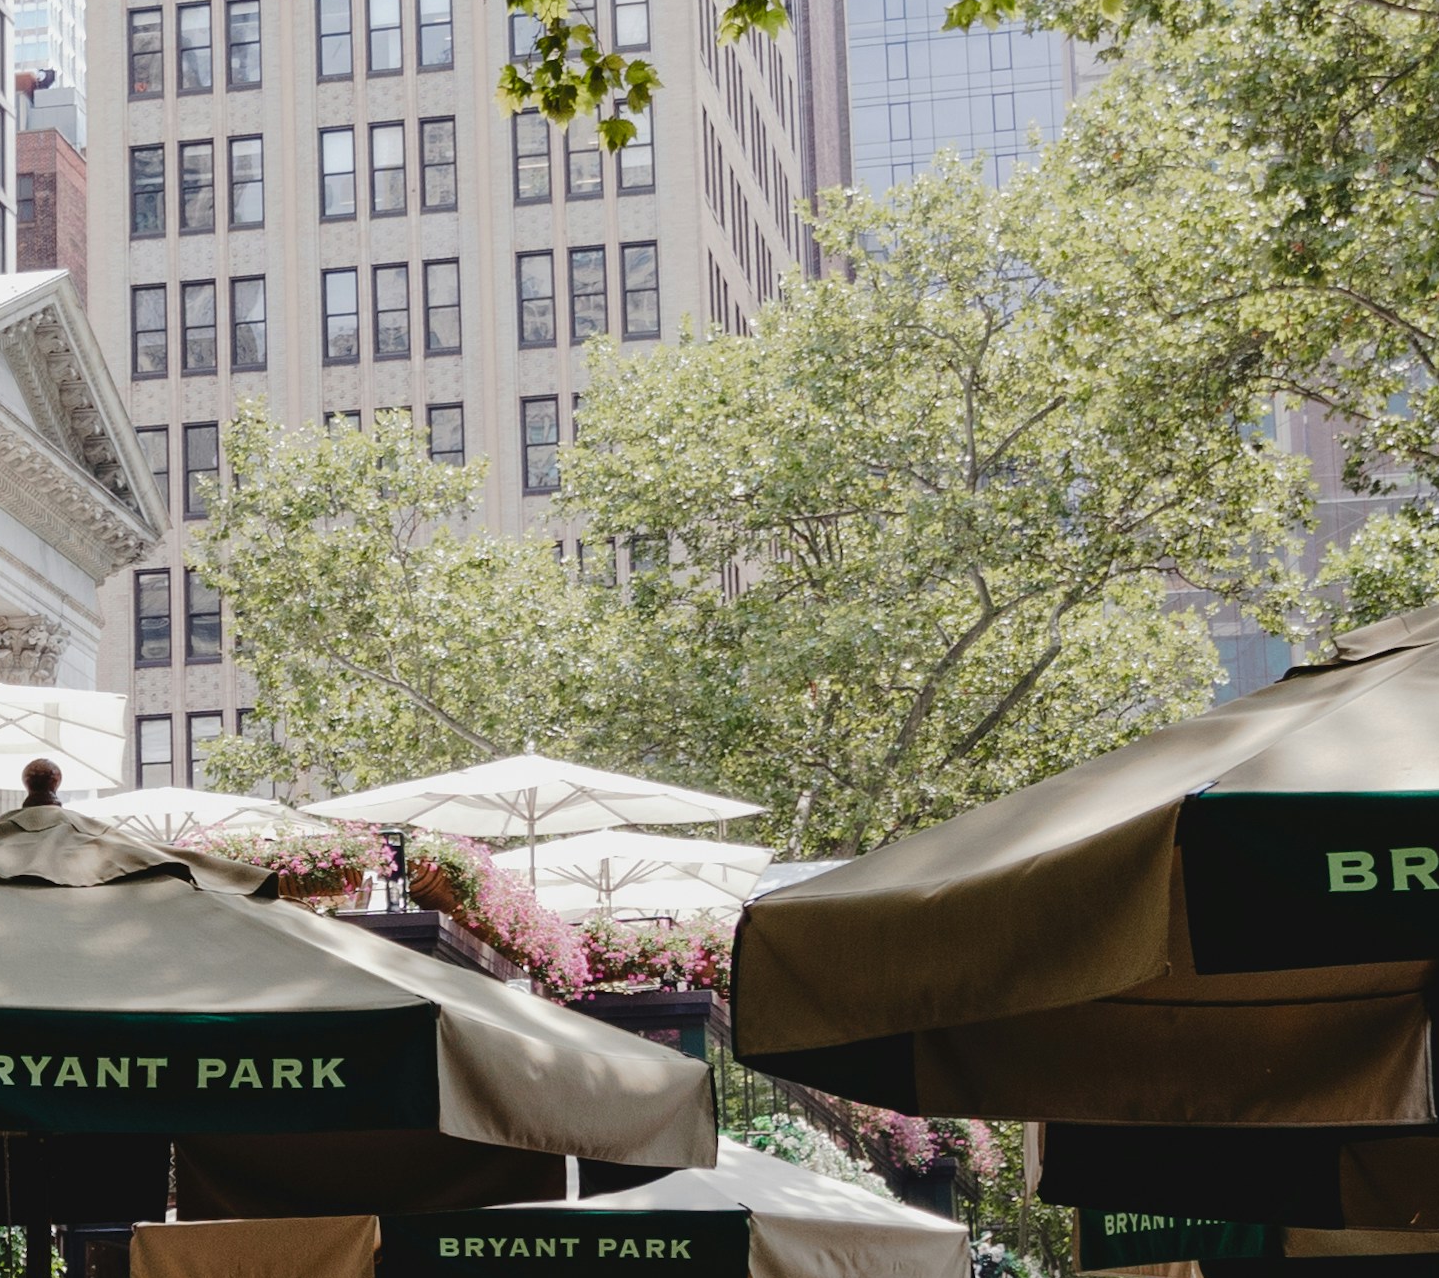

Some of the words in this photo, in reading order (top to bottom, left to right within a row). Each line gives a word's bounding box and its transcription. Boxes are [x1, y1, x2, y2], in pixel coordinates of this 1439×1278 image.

[196, 1057, 346, 1089] PARK
[439, 1237, 580, 1257] BRYANT
[598, 1238, 692, 1259] PARK
